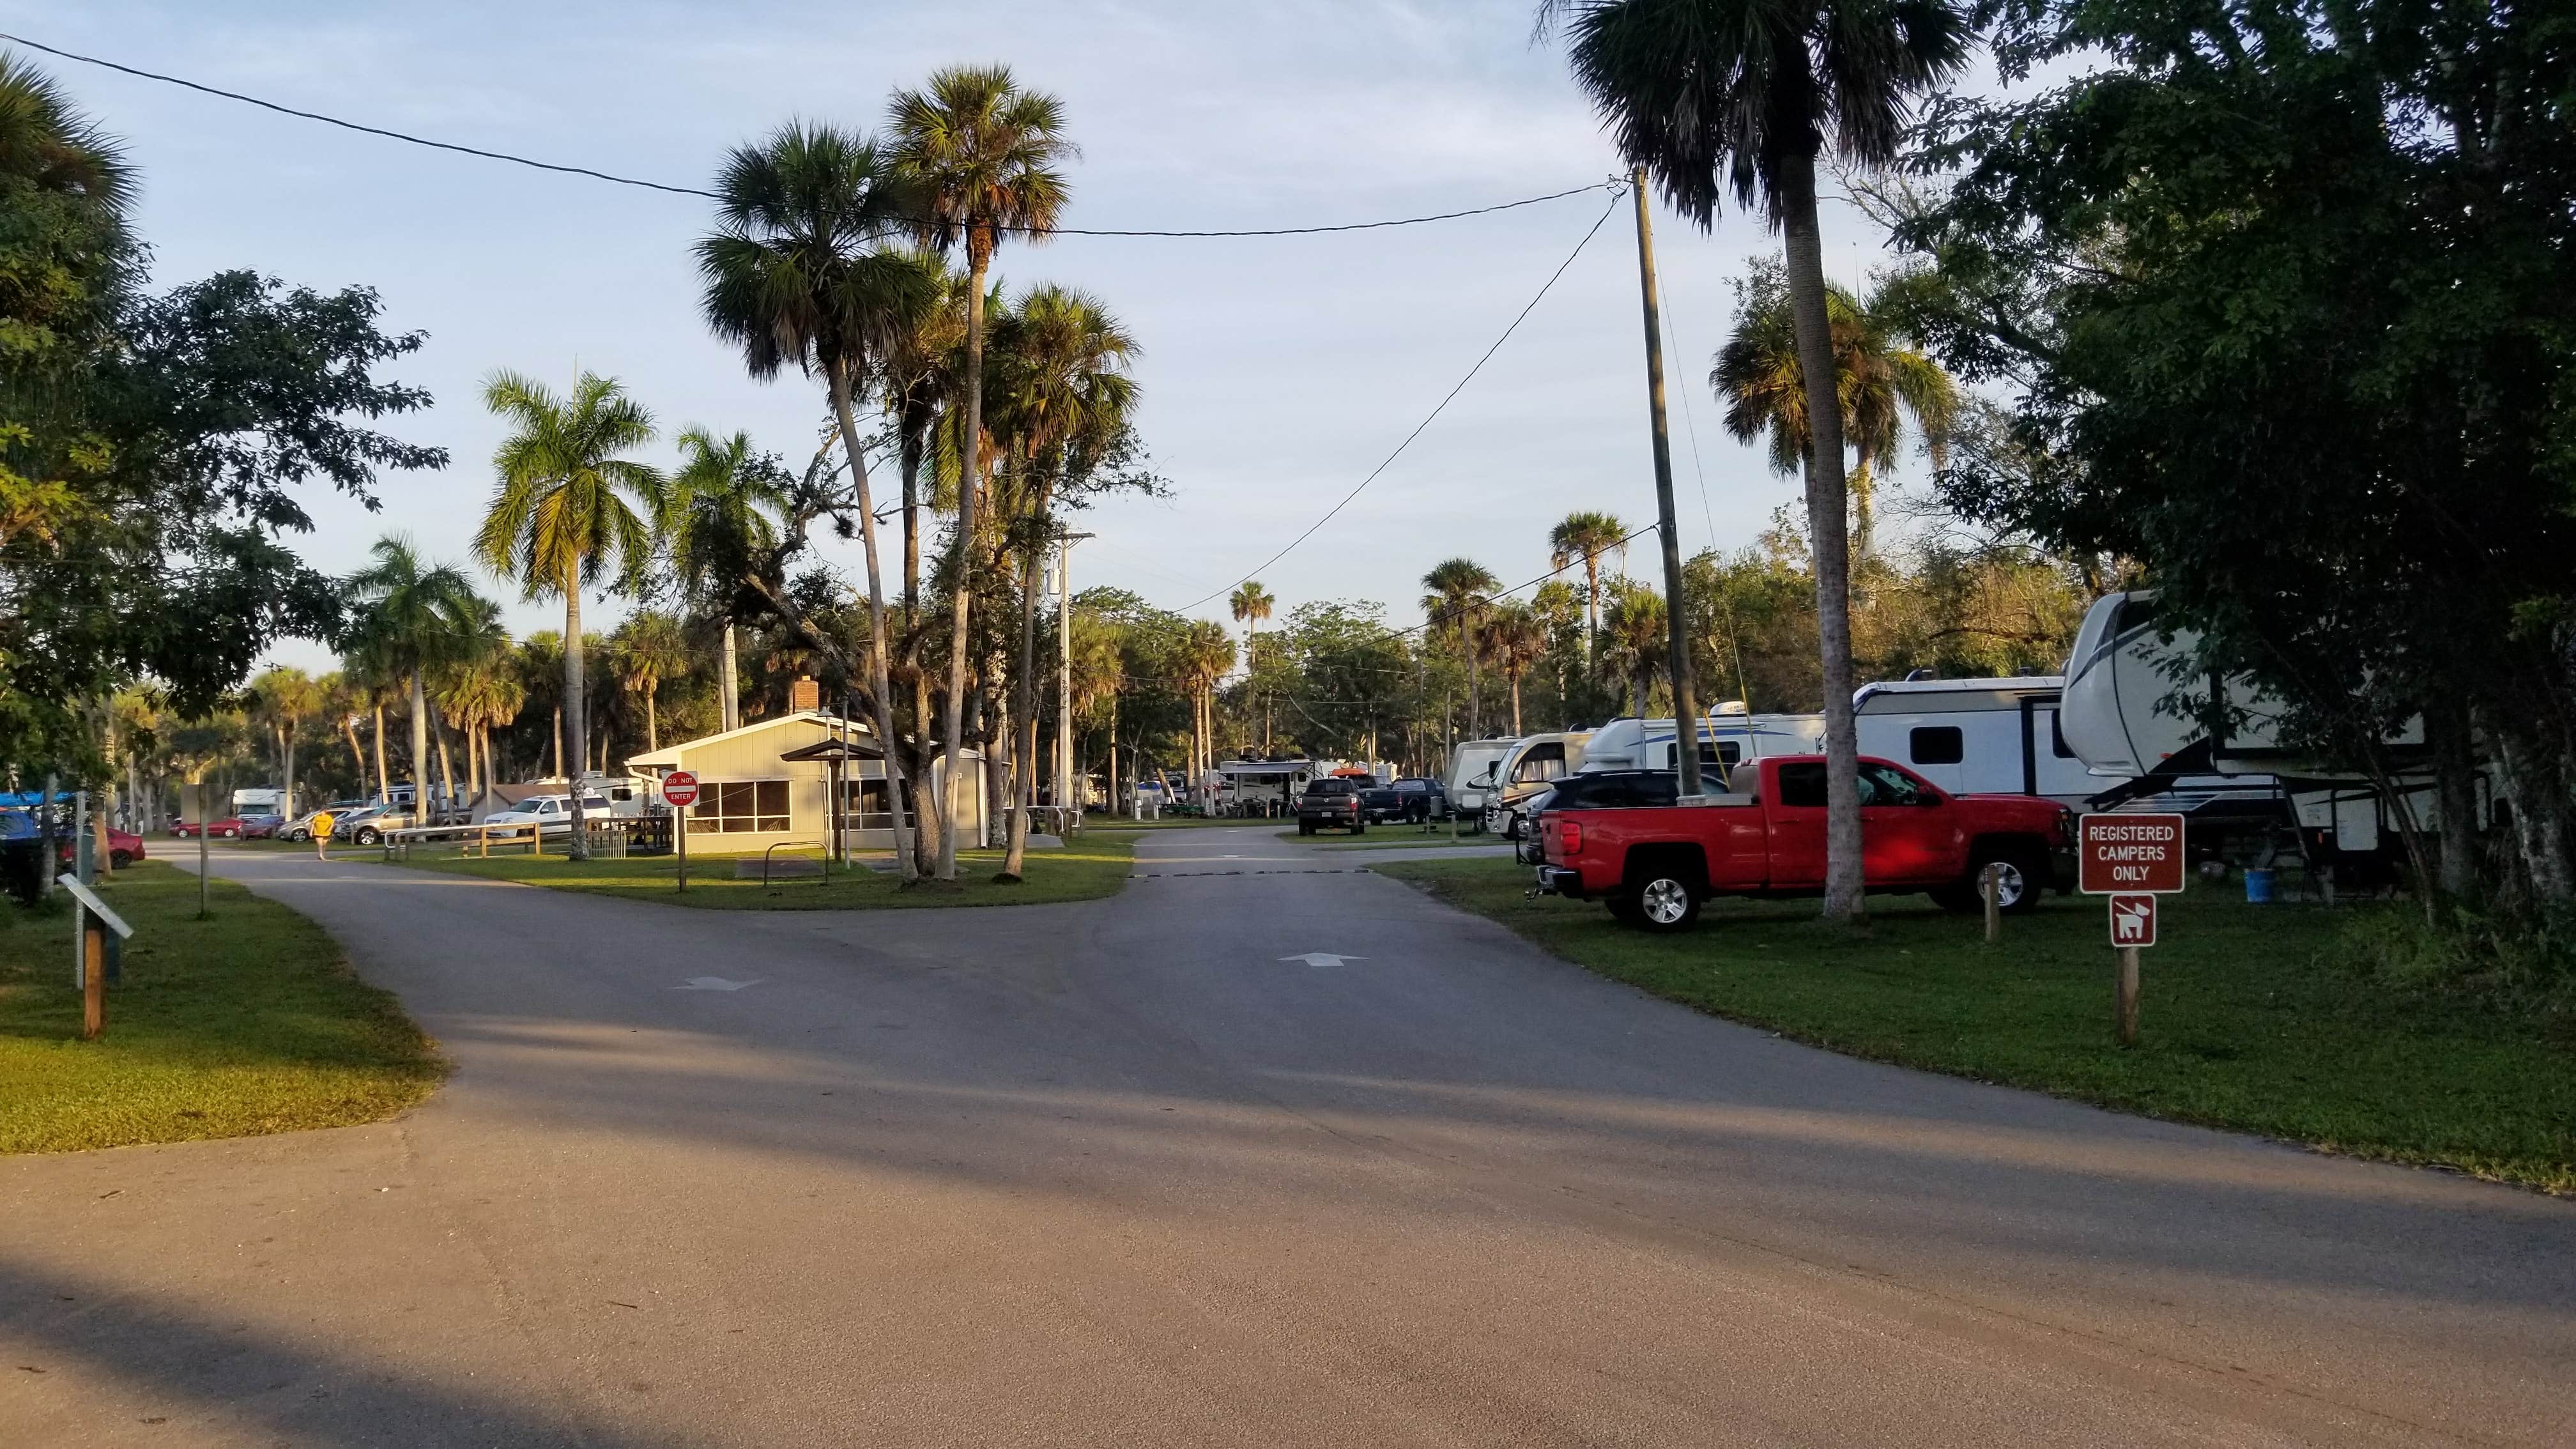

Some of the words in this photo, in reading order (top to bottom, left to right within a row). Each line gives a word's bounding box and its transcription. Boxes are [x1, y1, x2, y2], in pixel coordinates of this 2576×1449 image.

[2090, 826, 2174, 841] REGISTERED
[2098, 847, 2165, 861] CAMPERS
[2113, 866, 2149, 880] ONLY
